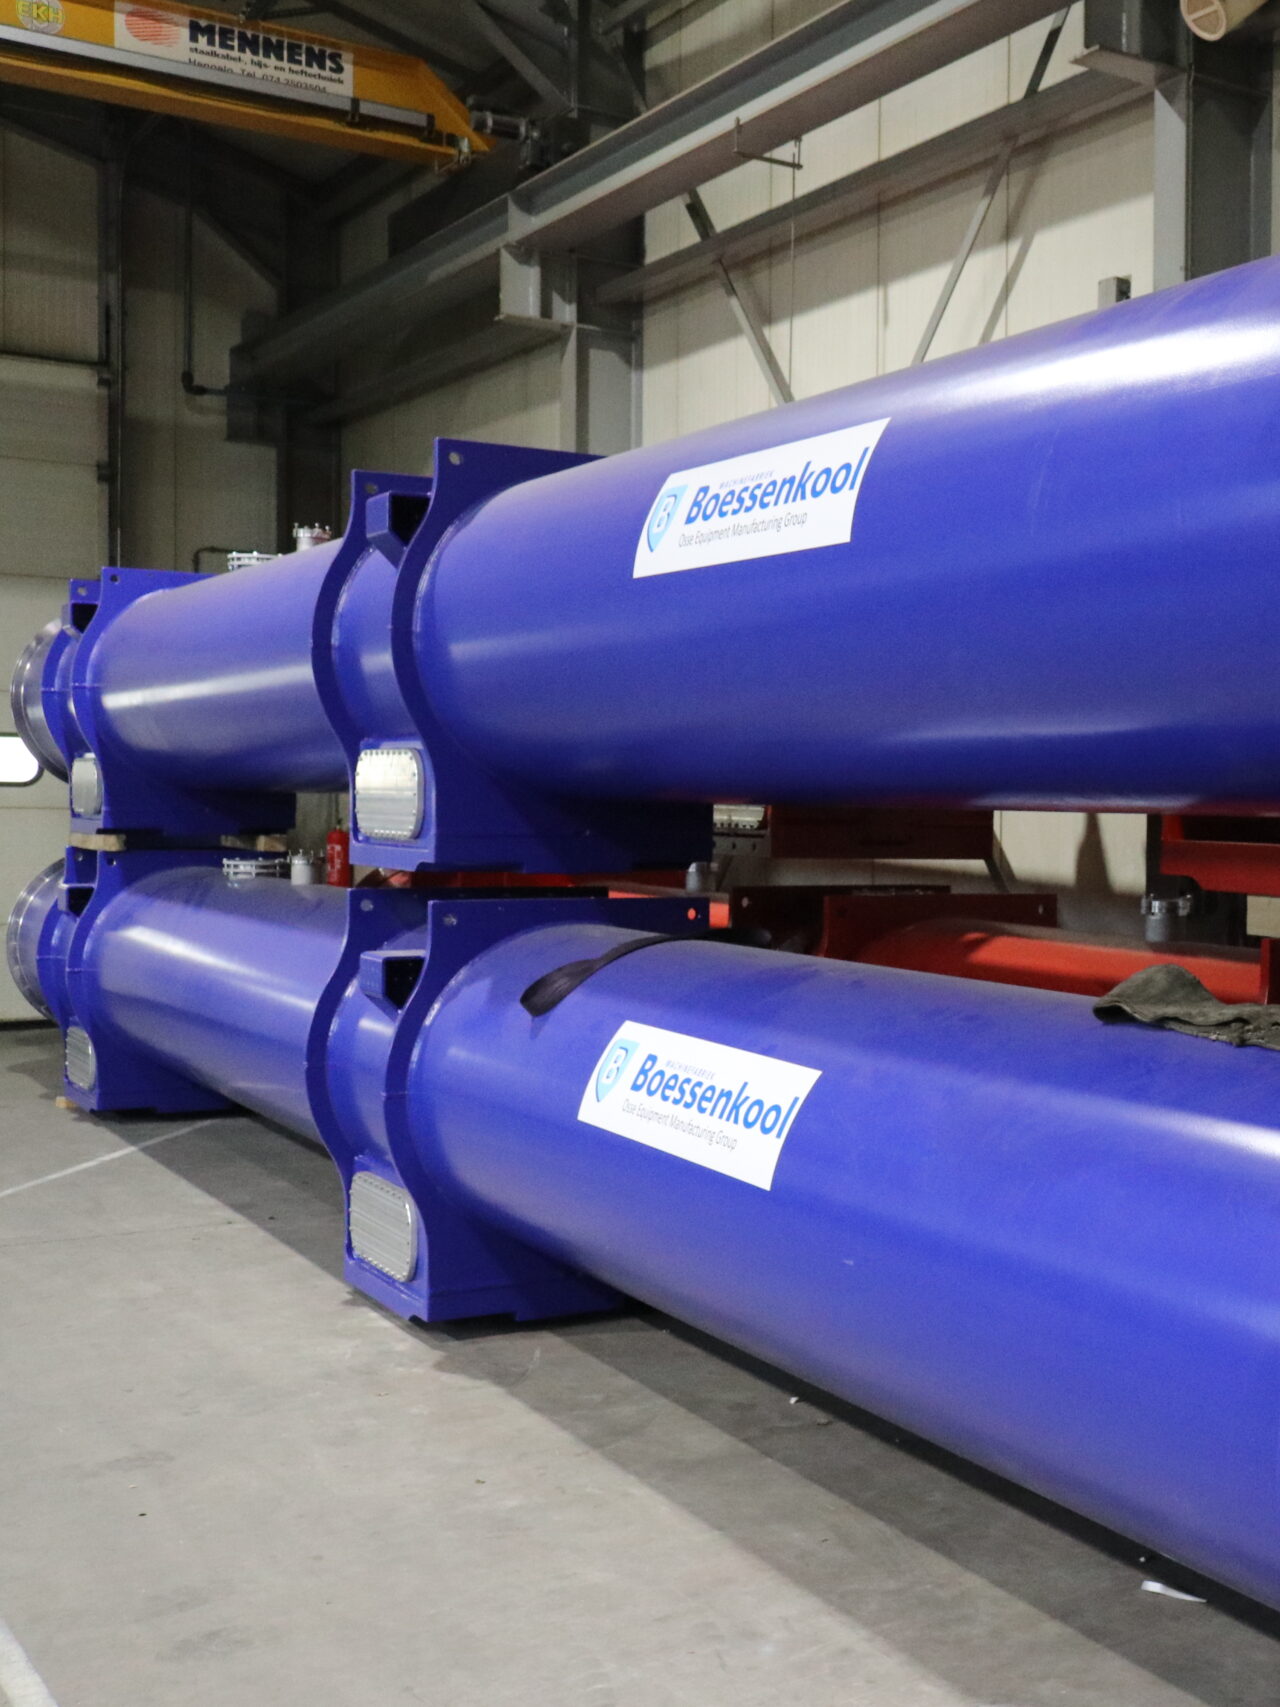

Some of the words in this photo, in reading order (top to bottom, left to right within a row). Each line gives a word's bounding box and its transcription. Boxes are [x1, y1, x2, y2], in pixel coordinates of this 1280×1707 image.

[188, 19, 345, 74] MENNENS
[274, 63, 286, 73] en
[684, 446, 870, 525] Boessenkool
[694, 527, 731, 546] Equipment
[732, 515, 783, 537] Manufacturing
[784, 511, 808, 529] Group
[630, 1053, 800, 1139] Boessenkool
[636, 1103, 670, 1126] Equipment
[670, 1114, 716, 1146] Manufacturing
[715, 1130, 738, 1152] Group
